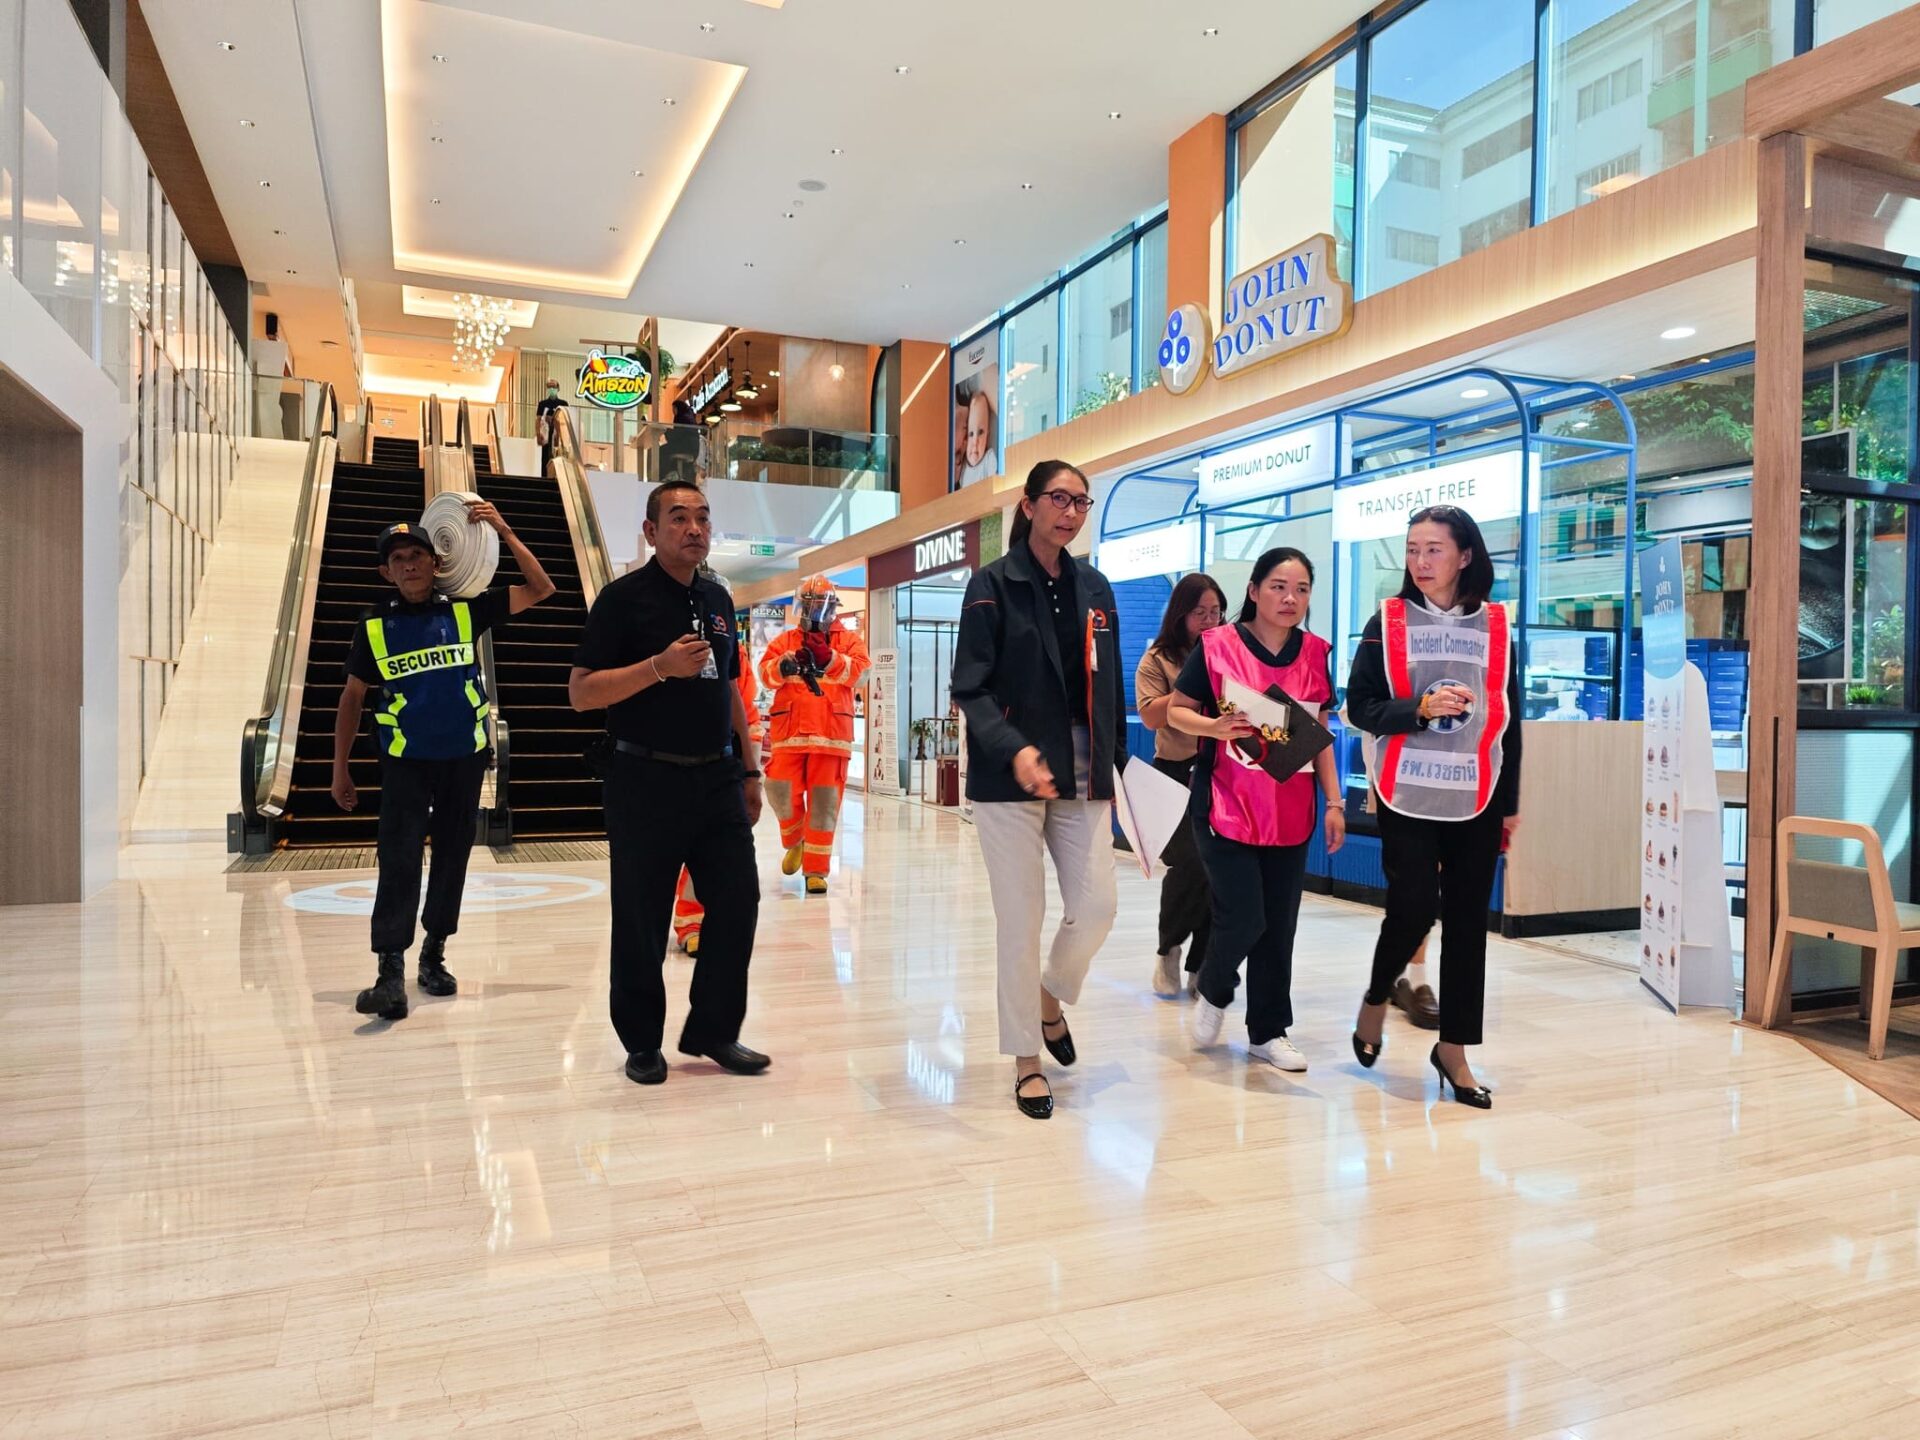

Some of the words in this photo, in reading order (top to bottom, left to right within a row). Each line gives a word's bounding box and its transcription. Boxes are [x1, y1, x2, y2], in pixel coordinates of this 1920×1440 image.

[1225, 252, 1312, 324] JOHN
[1213, 296, 1325, 368] DONUT
[1213, 458, 1262, 483] PREMIUM
[1266, 444, 1312, 470] DONUT
[1357, 488, 1432, 517] TRANSFAT
[1438, 478, 1476, 502] FREE
[915, 531, 966, 573] DIVINE
[387, 647, 466, 676] SECURITY
[1411, 632, 1443, 655] Incident
